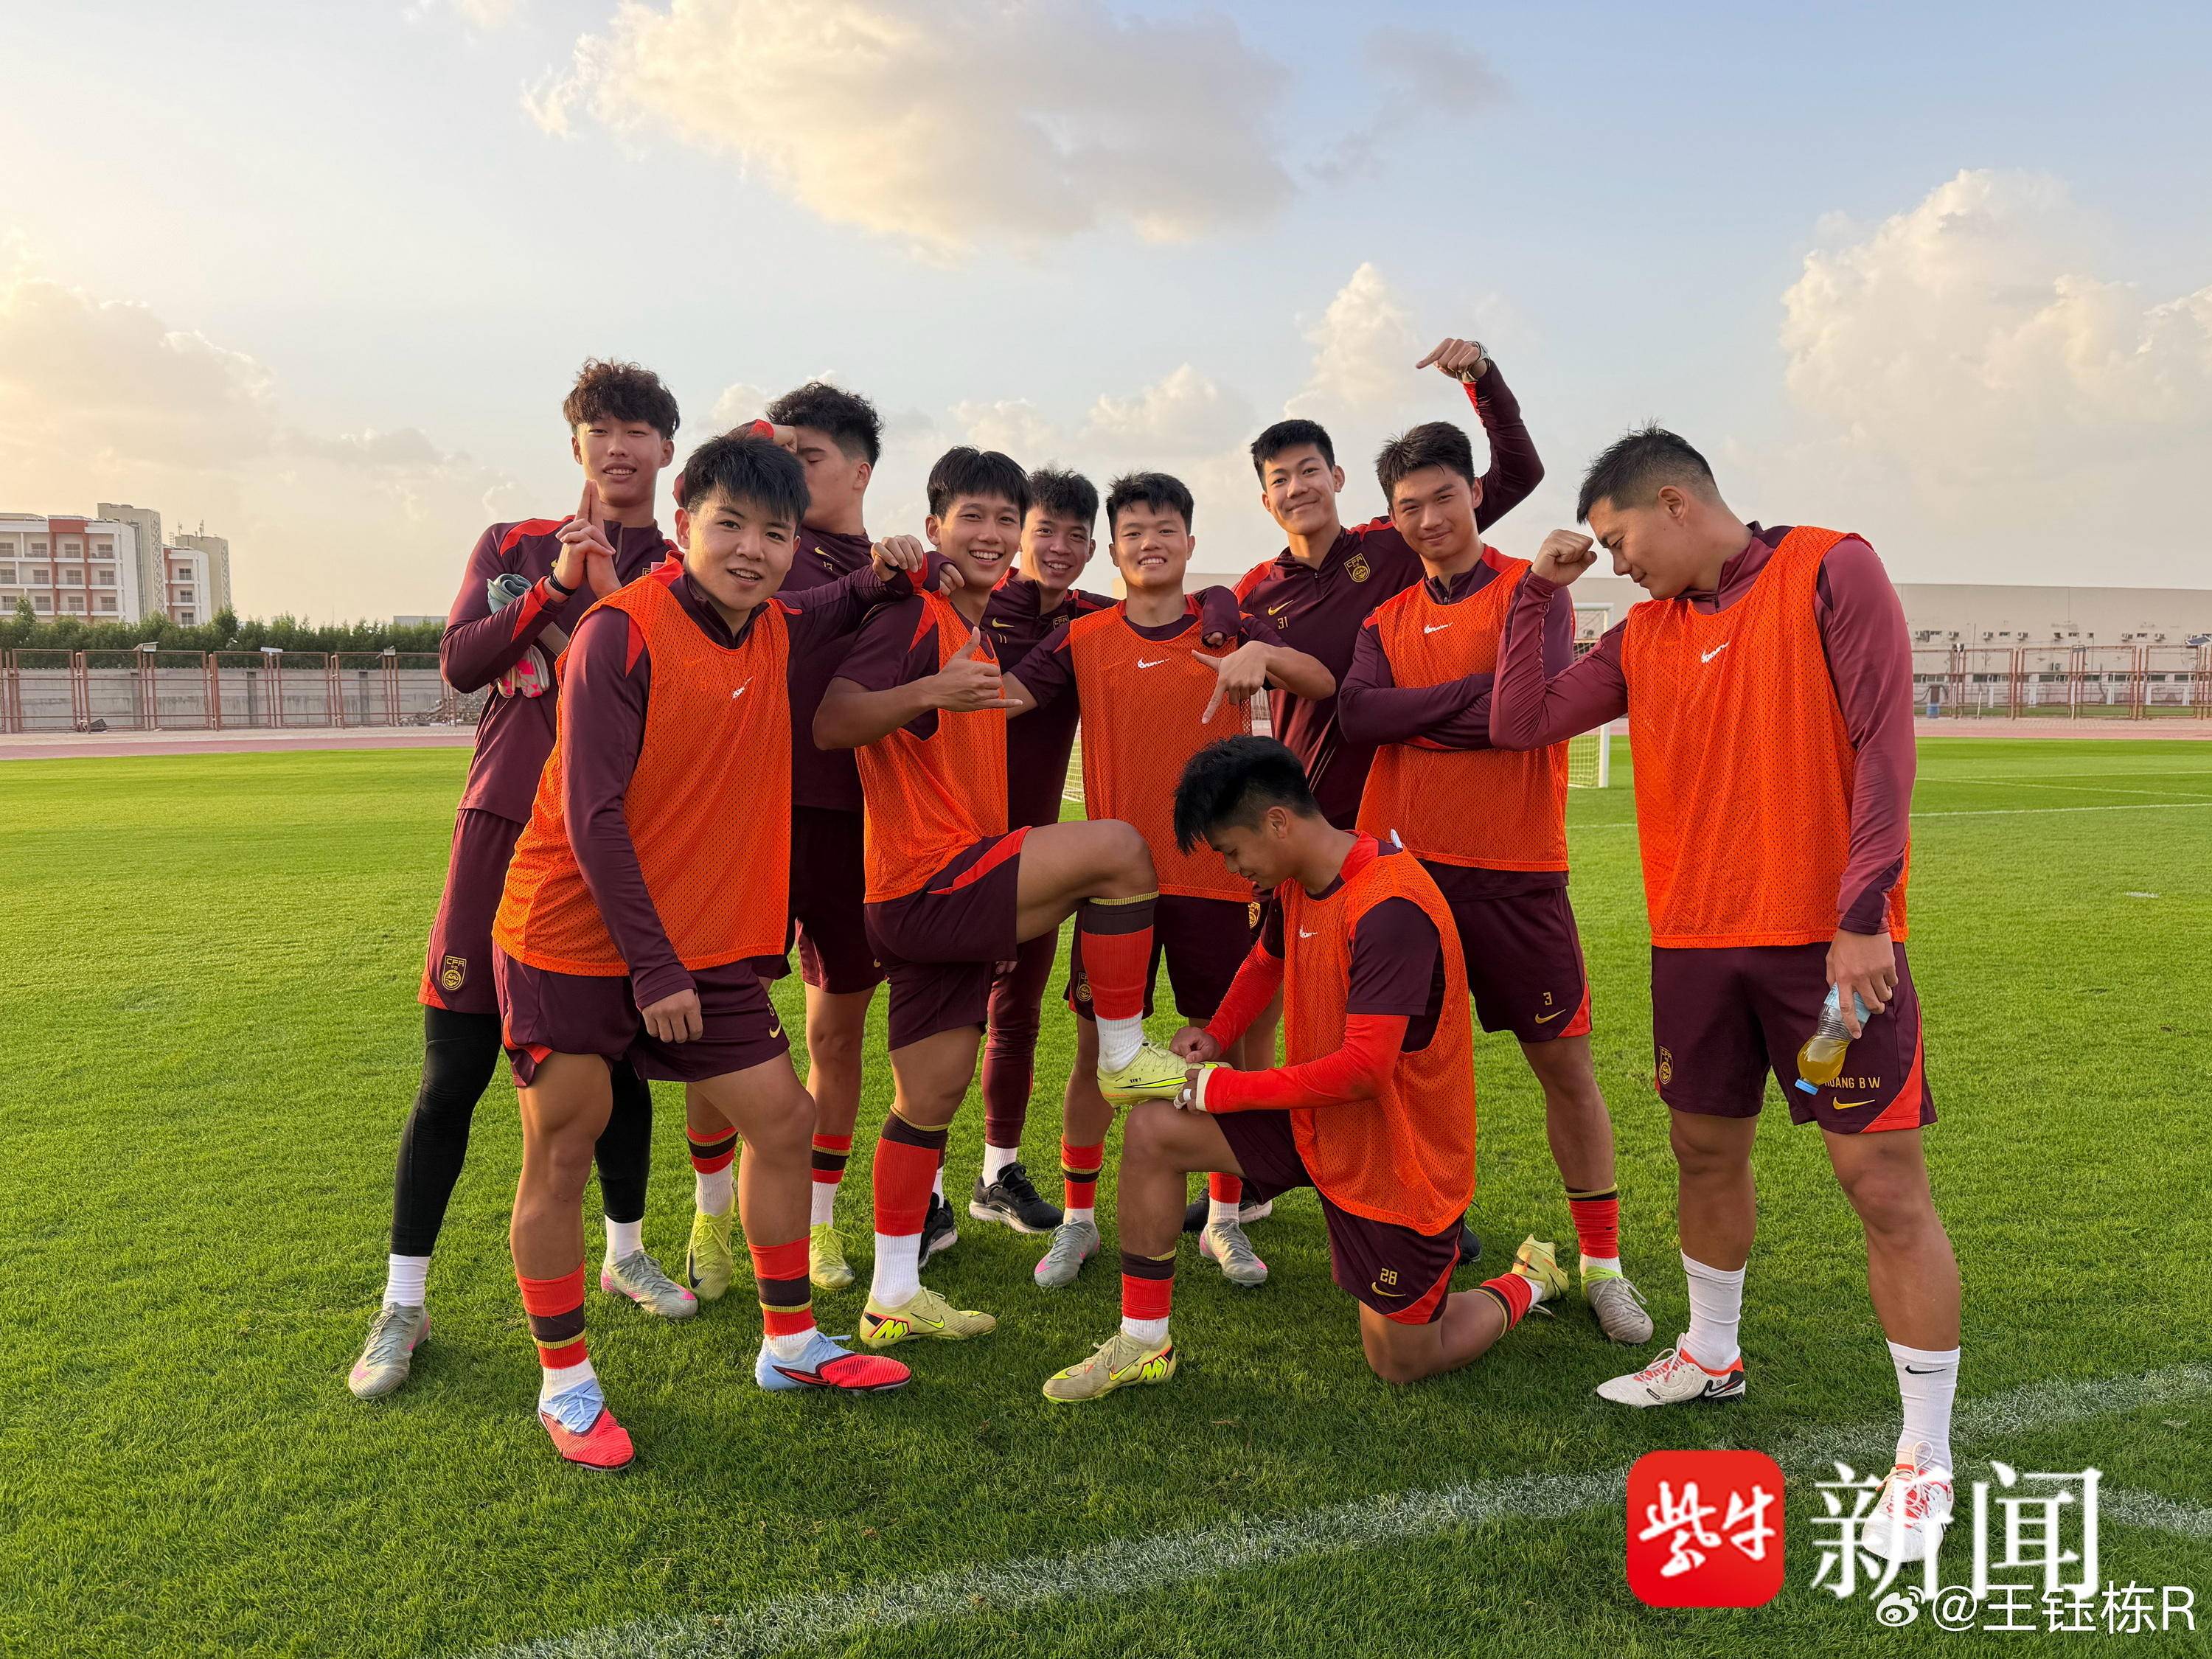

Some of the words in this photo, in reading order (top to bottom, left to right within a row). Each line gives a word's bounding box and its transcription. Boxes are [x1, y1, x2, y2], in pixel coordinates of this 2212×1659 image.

[1346, 555, 1363, 568] CFA
[1277, 616, 1288, 629] 31
[998, 633, 1007, 644] 11
[446, 958, 465, 967] CFA
[1543, 992, 1553, 1006] 3
[1859, 1077, 1866, 1088] B
[1868, 1077, 1880, 1088] W
[1380, 1267, 1398, 1286] 28
